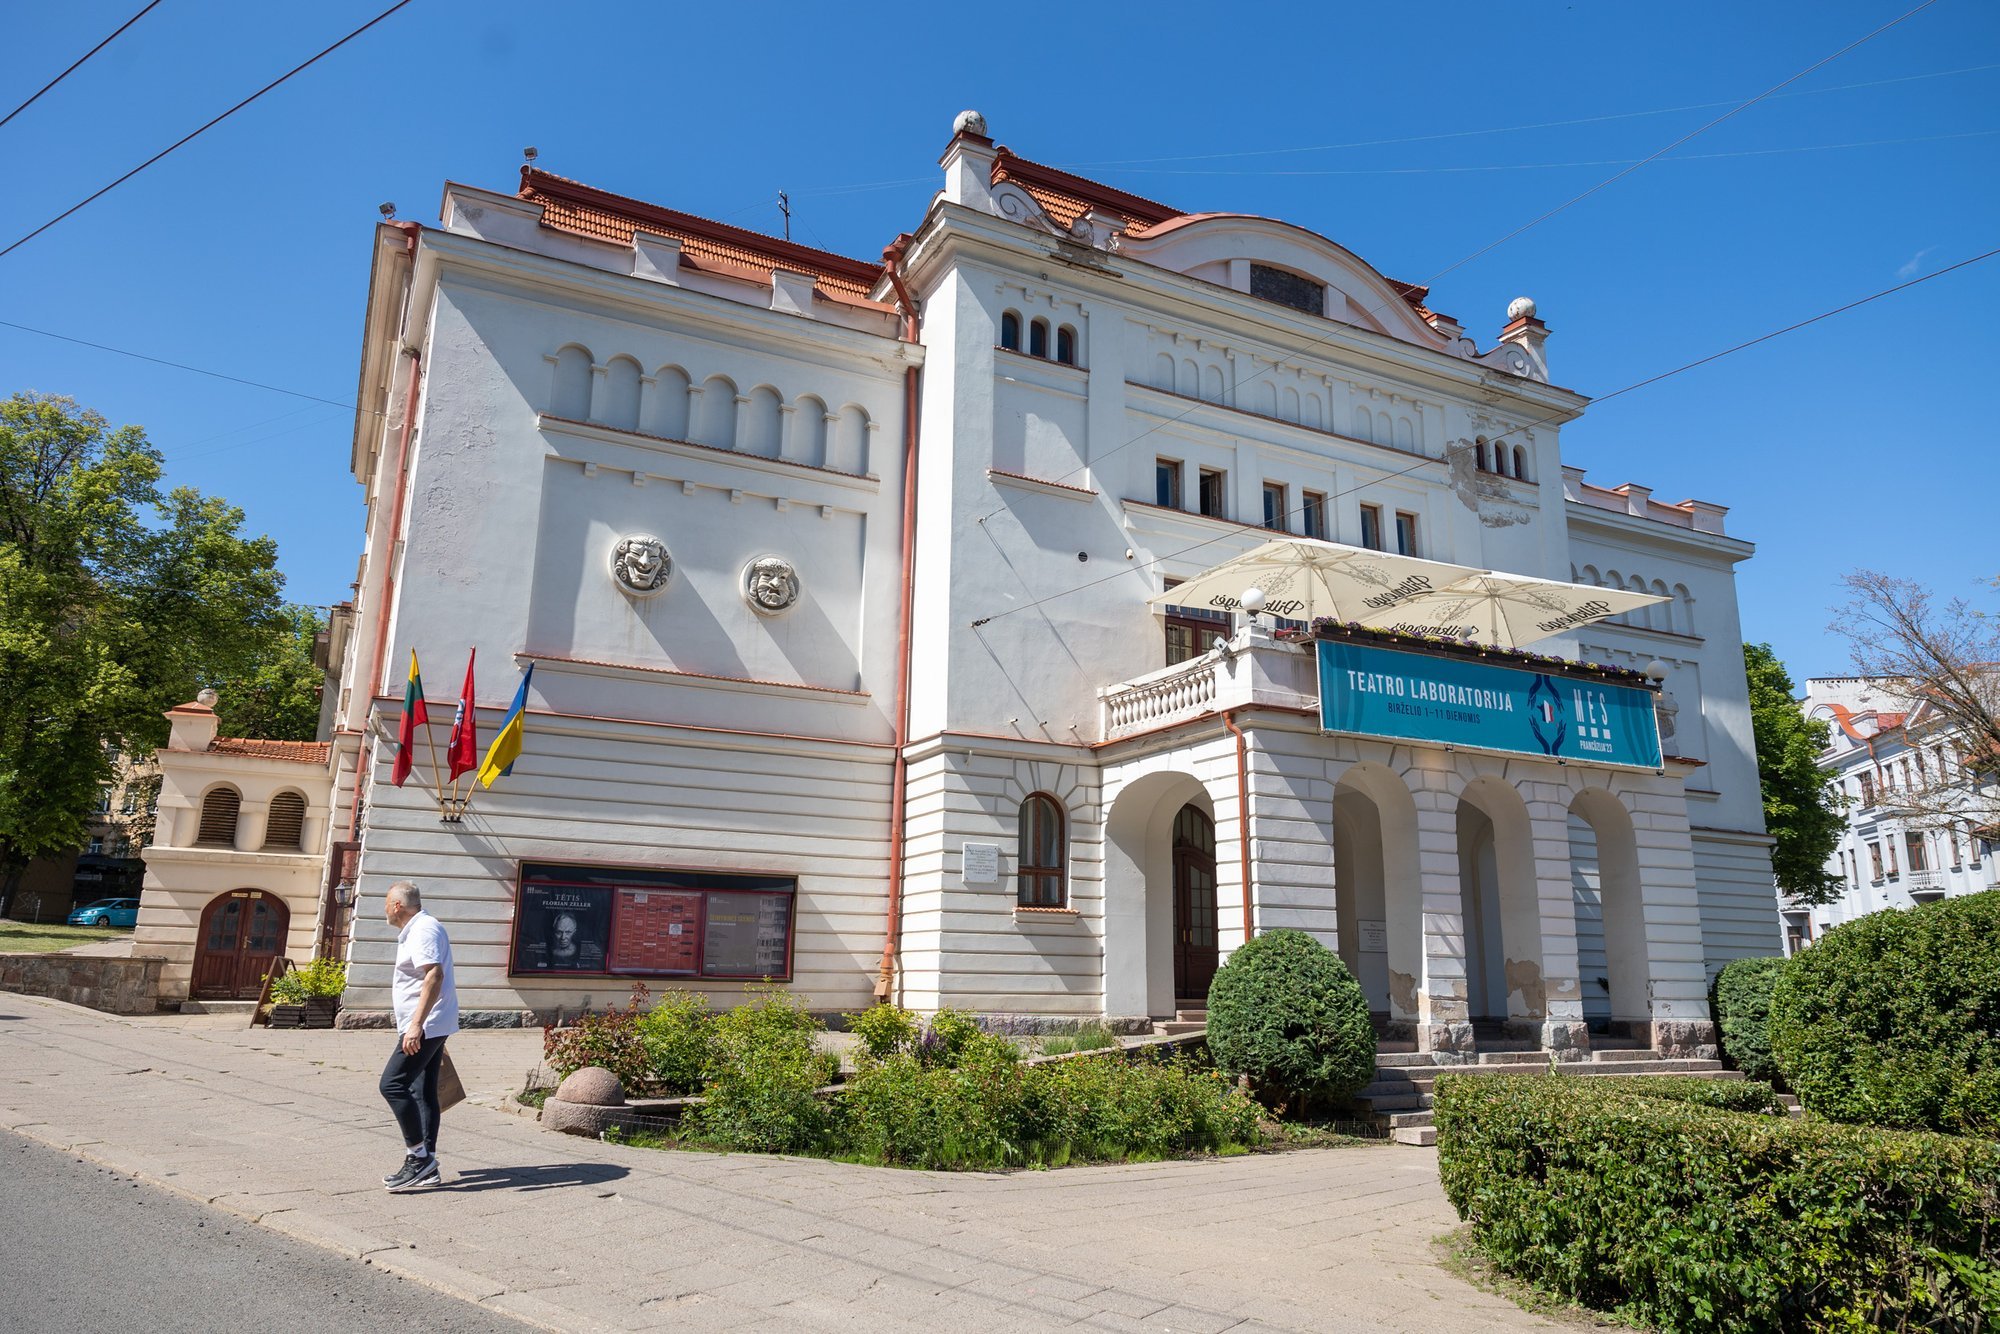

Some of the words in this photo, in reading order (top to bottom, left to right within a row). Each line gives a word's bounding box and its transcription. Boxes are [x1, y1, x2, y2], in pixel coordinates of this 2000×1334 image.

[1347, 670, 1405, 697] TEATRO
[1410, 679, 1513, 712] LABORATORIJA
[1573, 688, 1608, 725] MES
[1388, 702, 1422, 717] BIRŽELIO
[1446, 710, 1481, 724] DIENOMIS
